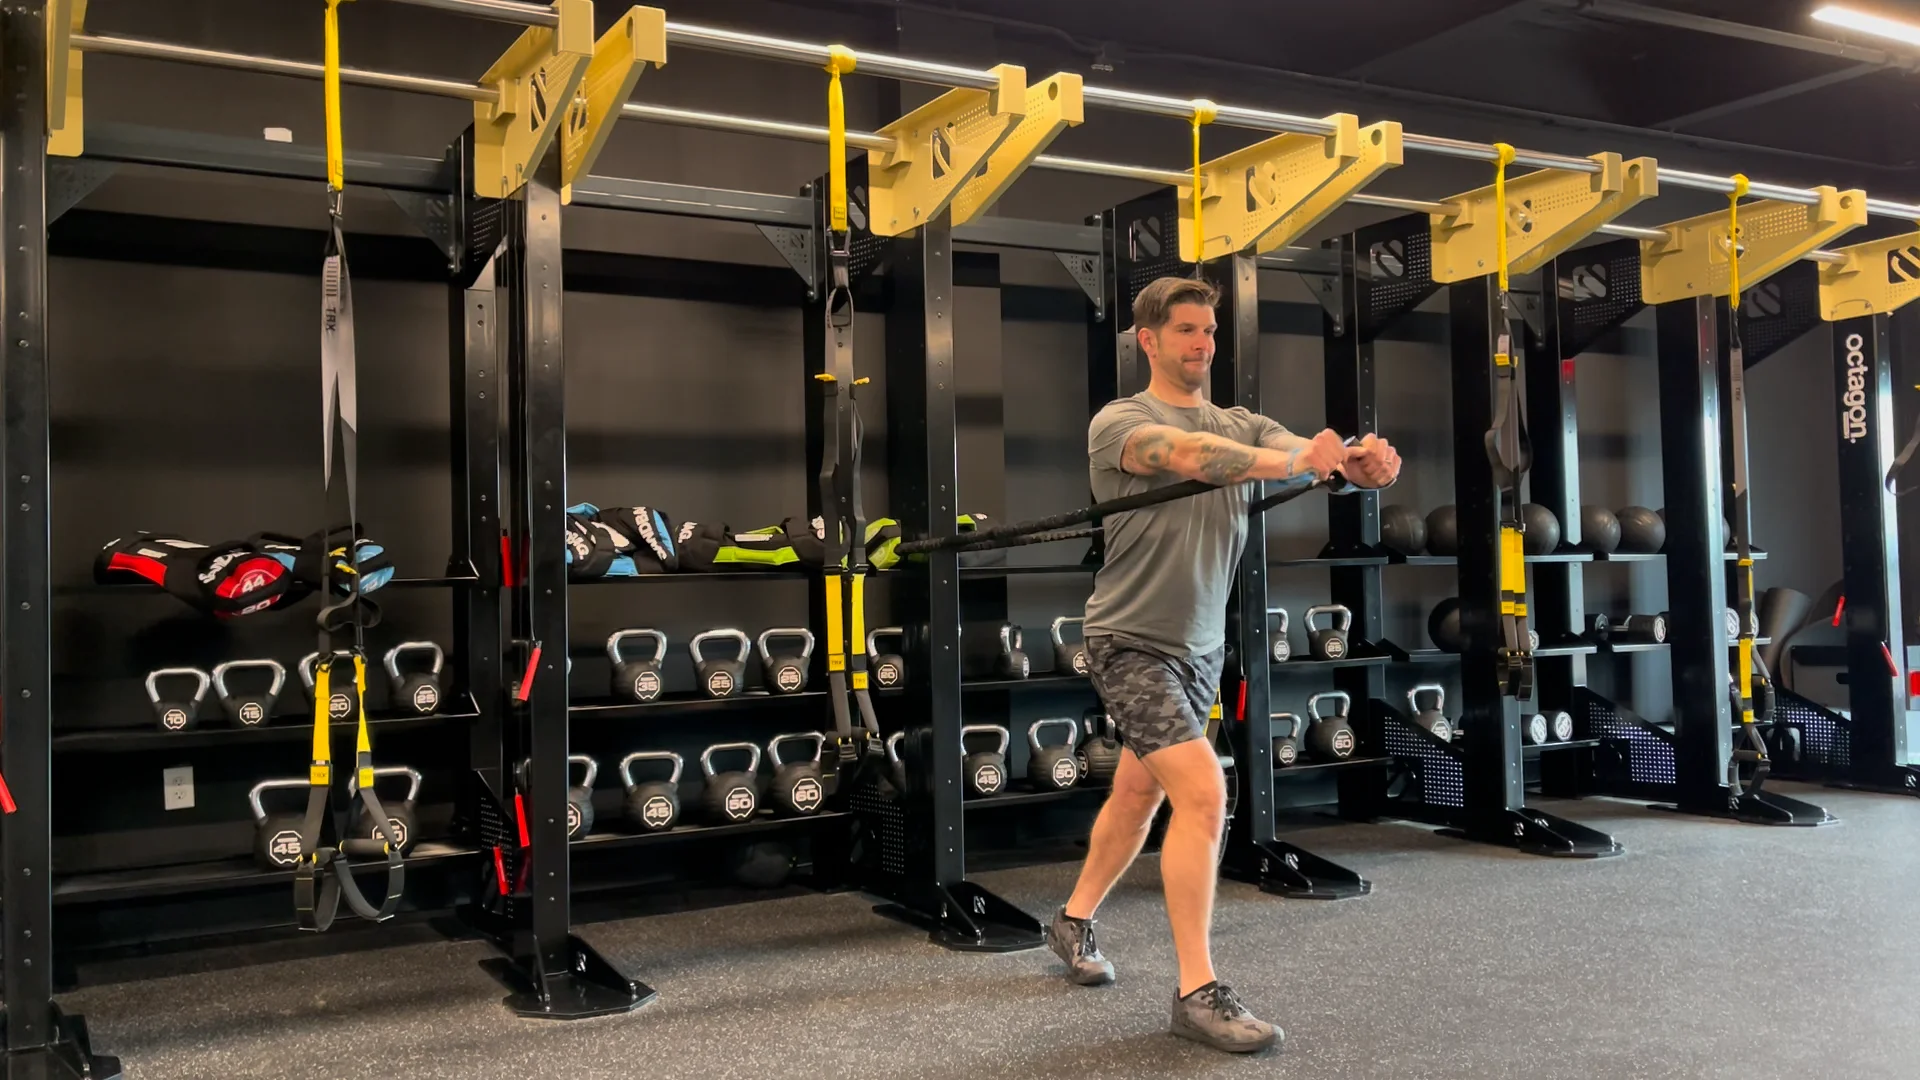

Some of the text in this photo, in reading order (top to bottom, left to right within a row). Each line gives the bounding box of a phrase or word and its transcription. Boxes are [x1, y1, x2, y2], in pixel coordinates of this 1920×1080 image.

[325, 307, 336, 331] TRX
[1843, 334, 1868, 439] octagon
[780, 674, 798, 683] 25
[638, 681, 658, 692] 35
[711, 679, 730, 689] 25
[417, 693, 435, 704] 25
[330, 702, 348, 711] 20
[167, 715, 183, 724] 10
[243, 710, 260, 719] 15
[978, 774, 997, 784] 45
[647, 806, 669, 818] 45
[273, 842, 301, 855] 45
